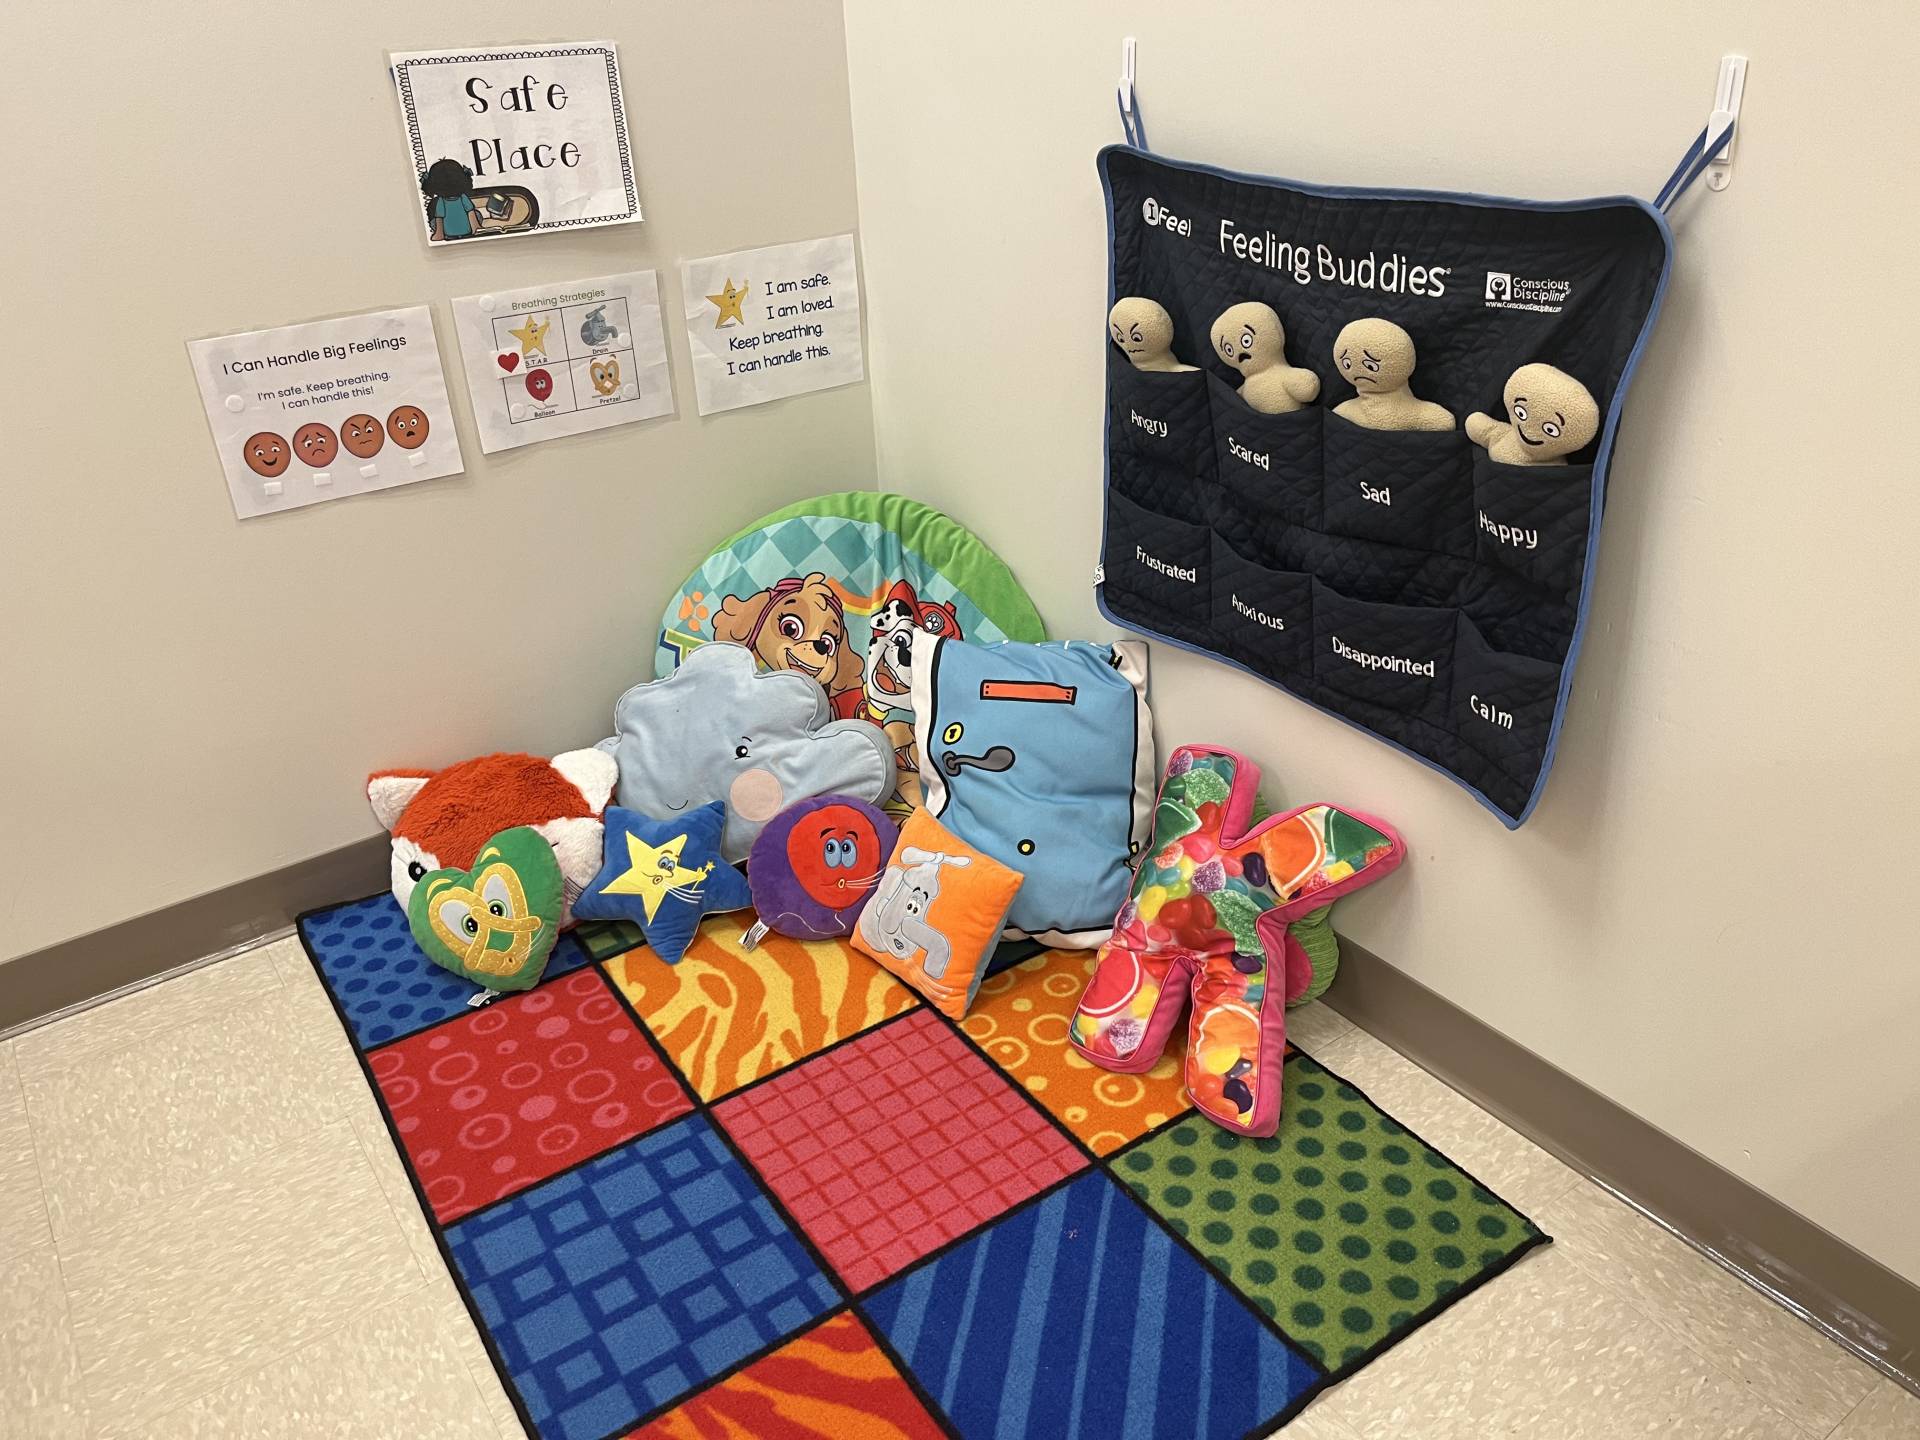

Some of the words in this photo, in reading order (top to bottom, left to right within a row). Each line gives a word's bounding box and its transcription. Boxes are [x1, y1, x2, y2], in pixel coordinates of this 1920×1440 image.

[465, 75, 568, 113] Safe
[468, 138, 581, 176] Place
[1158, 206, 1191, 238] Feel
[1220, 219, 1311, 285] Feeling
[765, 282, 774, 296] I
[776, 281, 798, 294] am
[800, 273, 831, 290] safe.
[1513, 277, 1569, 290] Conscious
[511, 296, 558, 311] Breathing
[559, 289, 606, 303] Strategies
[766, 306, 775, 320] I
[777, 305, 798, 318] am
[729, 336, 760, 350] Keep
[763, 324, 823, 344] breathing.
[223, 364, 228, 375] I
[231, 359, 264, 374] Can
[266, 349, 320, 368] Handle
[323, 345, 346, 360] Big
[349, 336, 407, 354] Feelings
[727, 362, 736, 376] I
[738, 360, 762, 373] can
[763, 349, 803, 368] handle
[805, 345, 831, 360] this.
[258, 391, 276, 402] I'm
[277, 385, 305, 399] safe.
[306, 380, 335, 394] Keep
[336, 371, 391, 388] breathing.
[288, 398, 310, 409] can
[311, 391, 350, 404] handle
[351, 386, 375, 398] this!
[1131, 408, 1168, 438] Angry
[1228, 436, 1270, 472] Scared
[1360, 481, 1391, 506] Sad
[1479, 509, 1538, 550] Happy
[1136, 545, 1196, 584] Frustrated
[1231, 593, 1285, 631] Anxious
[1332, 636, 1435, 678] Disappointed
[1470, 694, 1513, 730] Calm
